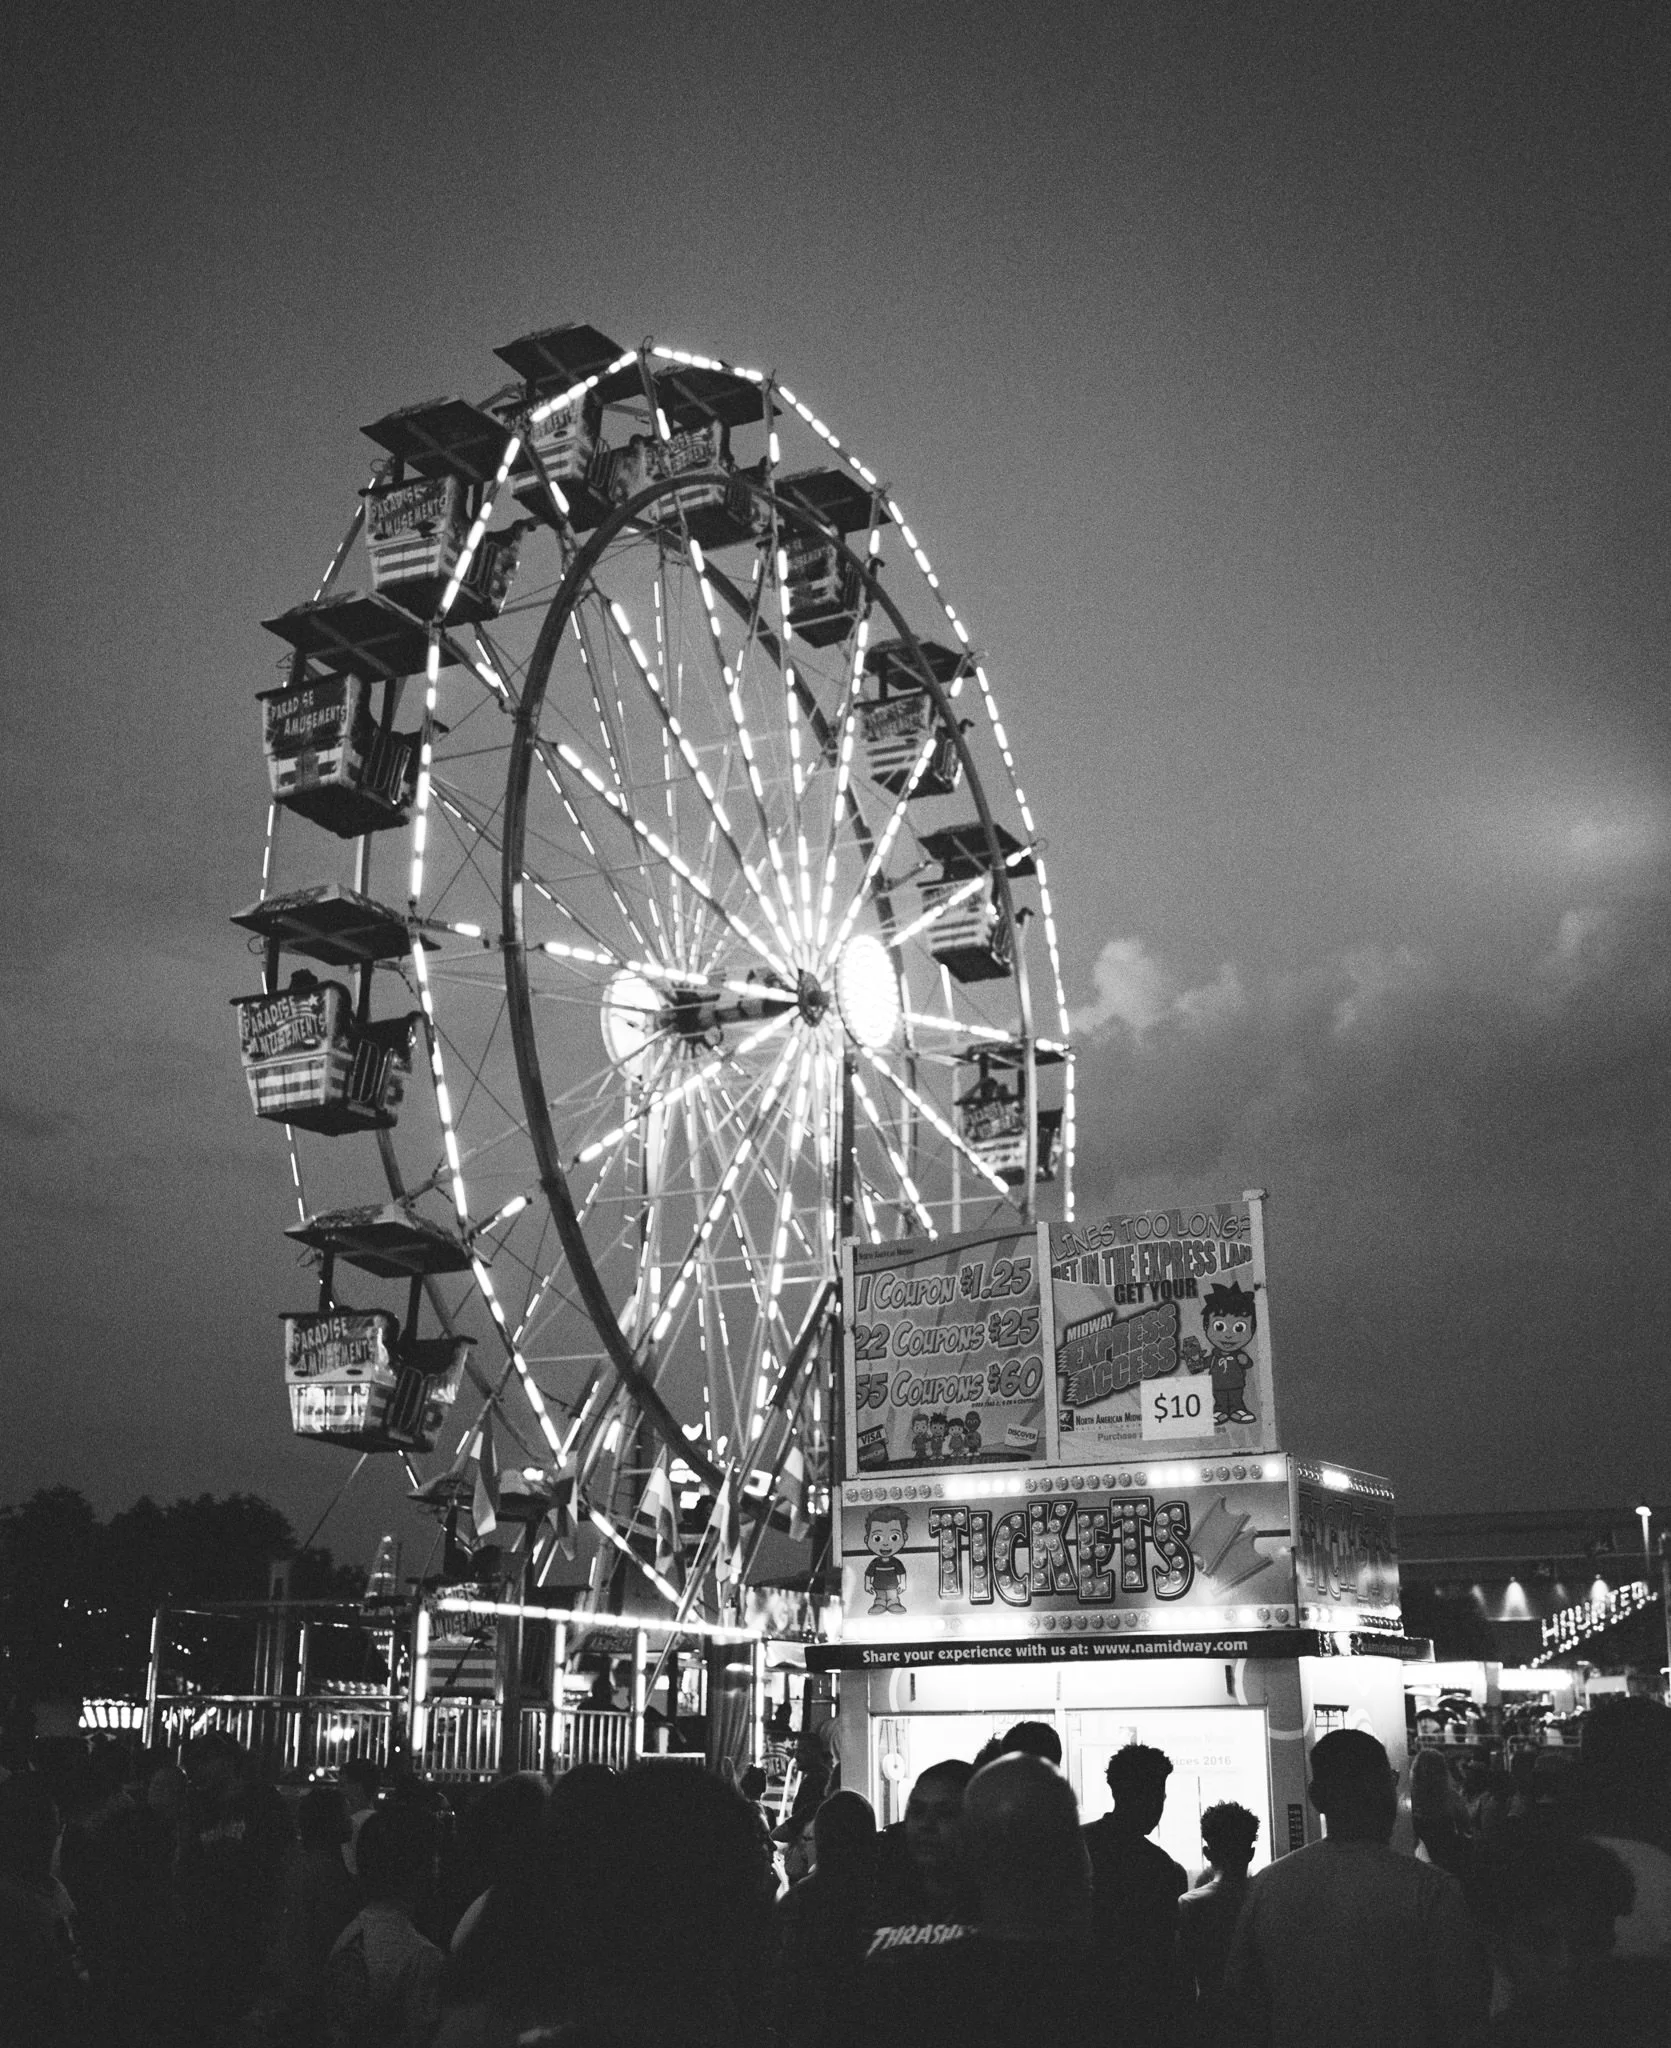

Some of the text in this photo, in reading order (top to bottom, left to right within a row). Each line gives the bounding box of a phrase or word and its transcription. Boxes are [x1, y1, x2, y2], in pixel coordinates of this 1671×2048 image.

[284, 704, 347, 736] AMUSEMENTS
[243, 995, 297, 1040] PARADISE
[247, 1013, 327, 1056] AMUSEMENTS
[1050, 1211, 1251, 1261] LINES TOO LONG?
[960, 1257, 1032, 1300] $1.25
[1081, 1252, 1100, 1286] IN
[1101, 1244, 1137, 1286] THE
[1137, 1239, 1219, 1283] EXPRESS
[1219, 1241, 1253, 1272] LAN
[1114, 1277, 1200, 1306] GET YOUR
[294, 1317, 348, 1352] PARADISE
[855, 1323, 890, 1361] 22
[988, 1307, 1041, 1348] $25
[1066, 1312, 1115, 1343] MIDWAY
[856, 1372, 889, 1410] 55
[987, 1356, 1043, 1398] $60
[1066, 1336, 1177, 1405] ACCESS
[1154, 1392, 1202, 1424] $10
[861, 1431, 882, 1445] VISA
[1007, 1428, 1037, 1440] DISCOVER
[929, 1496, 1195, 1606] TICKETS
[1541, 1581, 1649, 1647] HAUNTED
[863, 1640, 1248, 1663] Share your experience with us at: www.namidway.com
[1171, 1755, 1232, 1766] rices 2016
